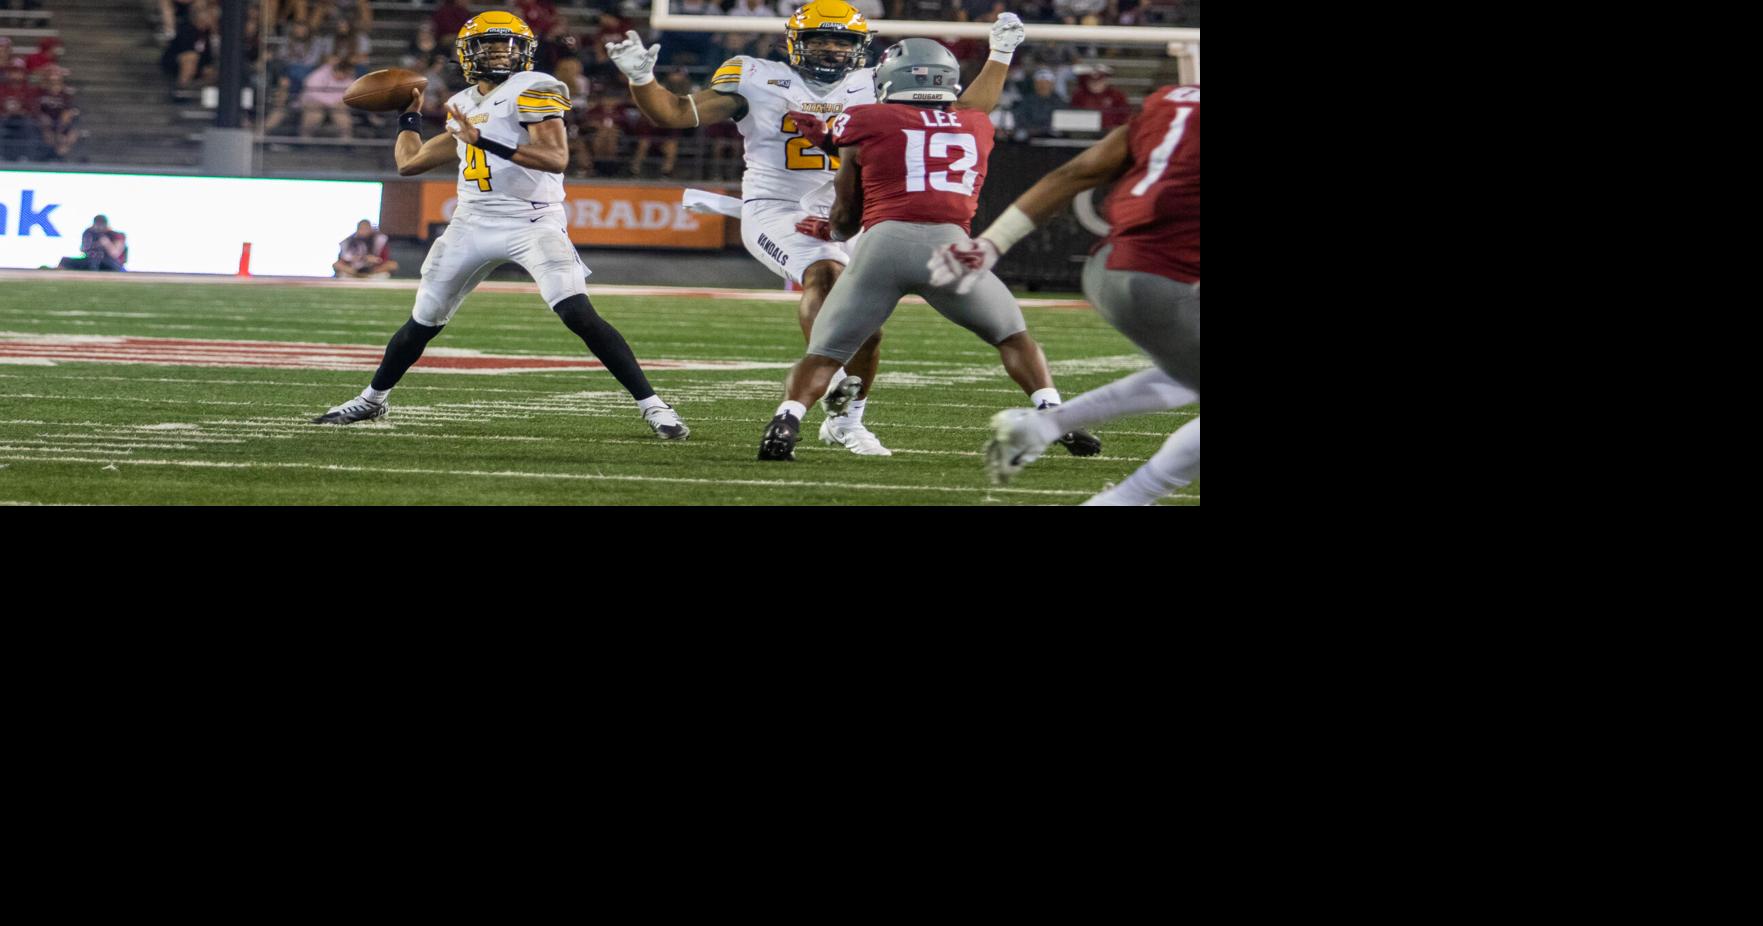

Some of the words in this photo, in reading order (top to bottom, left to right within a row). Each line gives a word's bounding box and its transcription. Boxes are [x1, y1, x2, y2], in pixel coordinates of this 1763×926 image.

[919, 110, 962, 127] LEE
[463, 143, 493, 192] 4
[901, 129, 979, 196] 13
[757, 232, 789, 267] VANDALS
